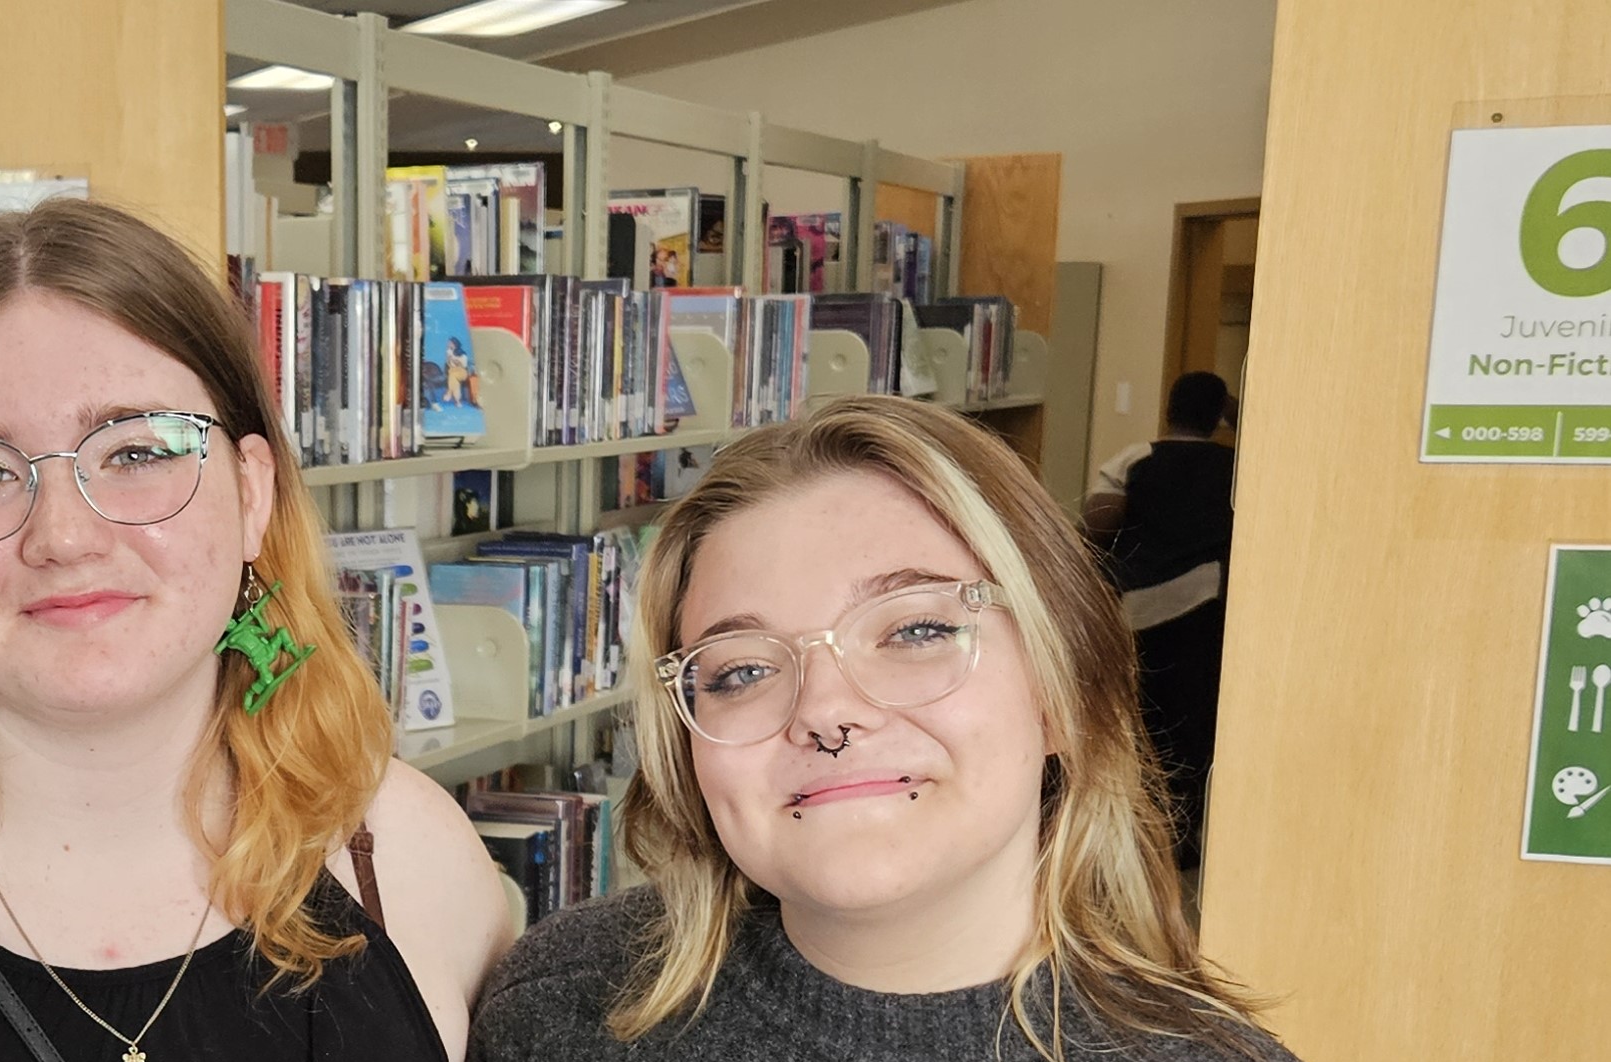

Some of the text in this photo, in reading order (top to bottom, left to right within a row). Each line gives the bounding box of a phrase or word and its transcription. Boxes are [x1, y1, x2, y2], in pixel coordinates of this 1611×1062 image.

[1519, 147, 1611, 297] 6
[1468, 352, 1611, 376] Non-Fict
[1462, 426, 1544, 441] 000-598
